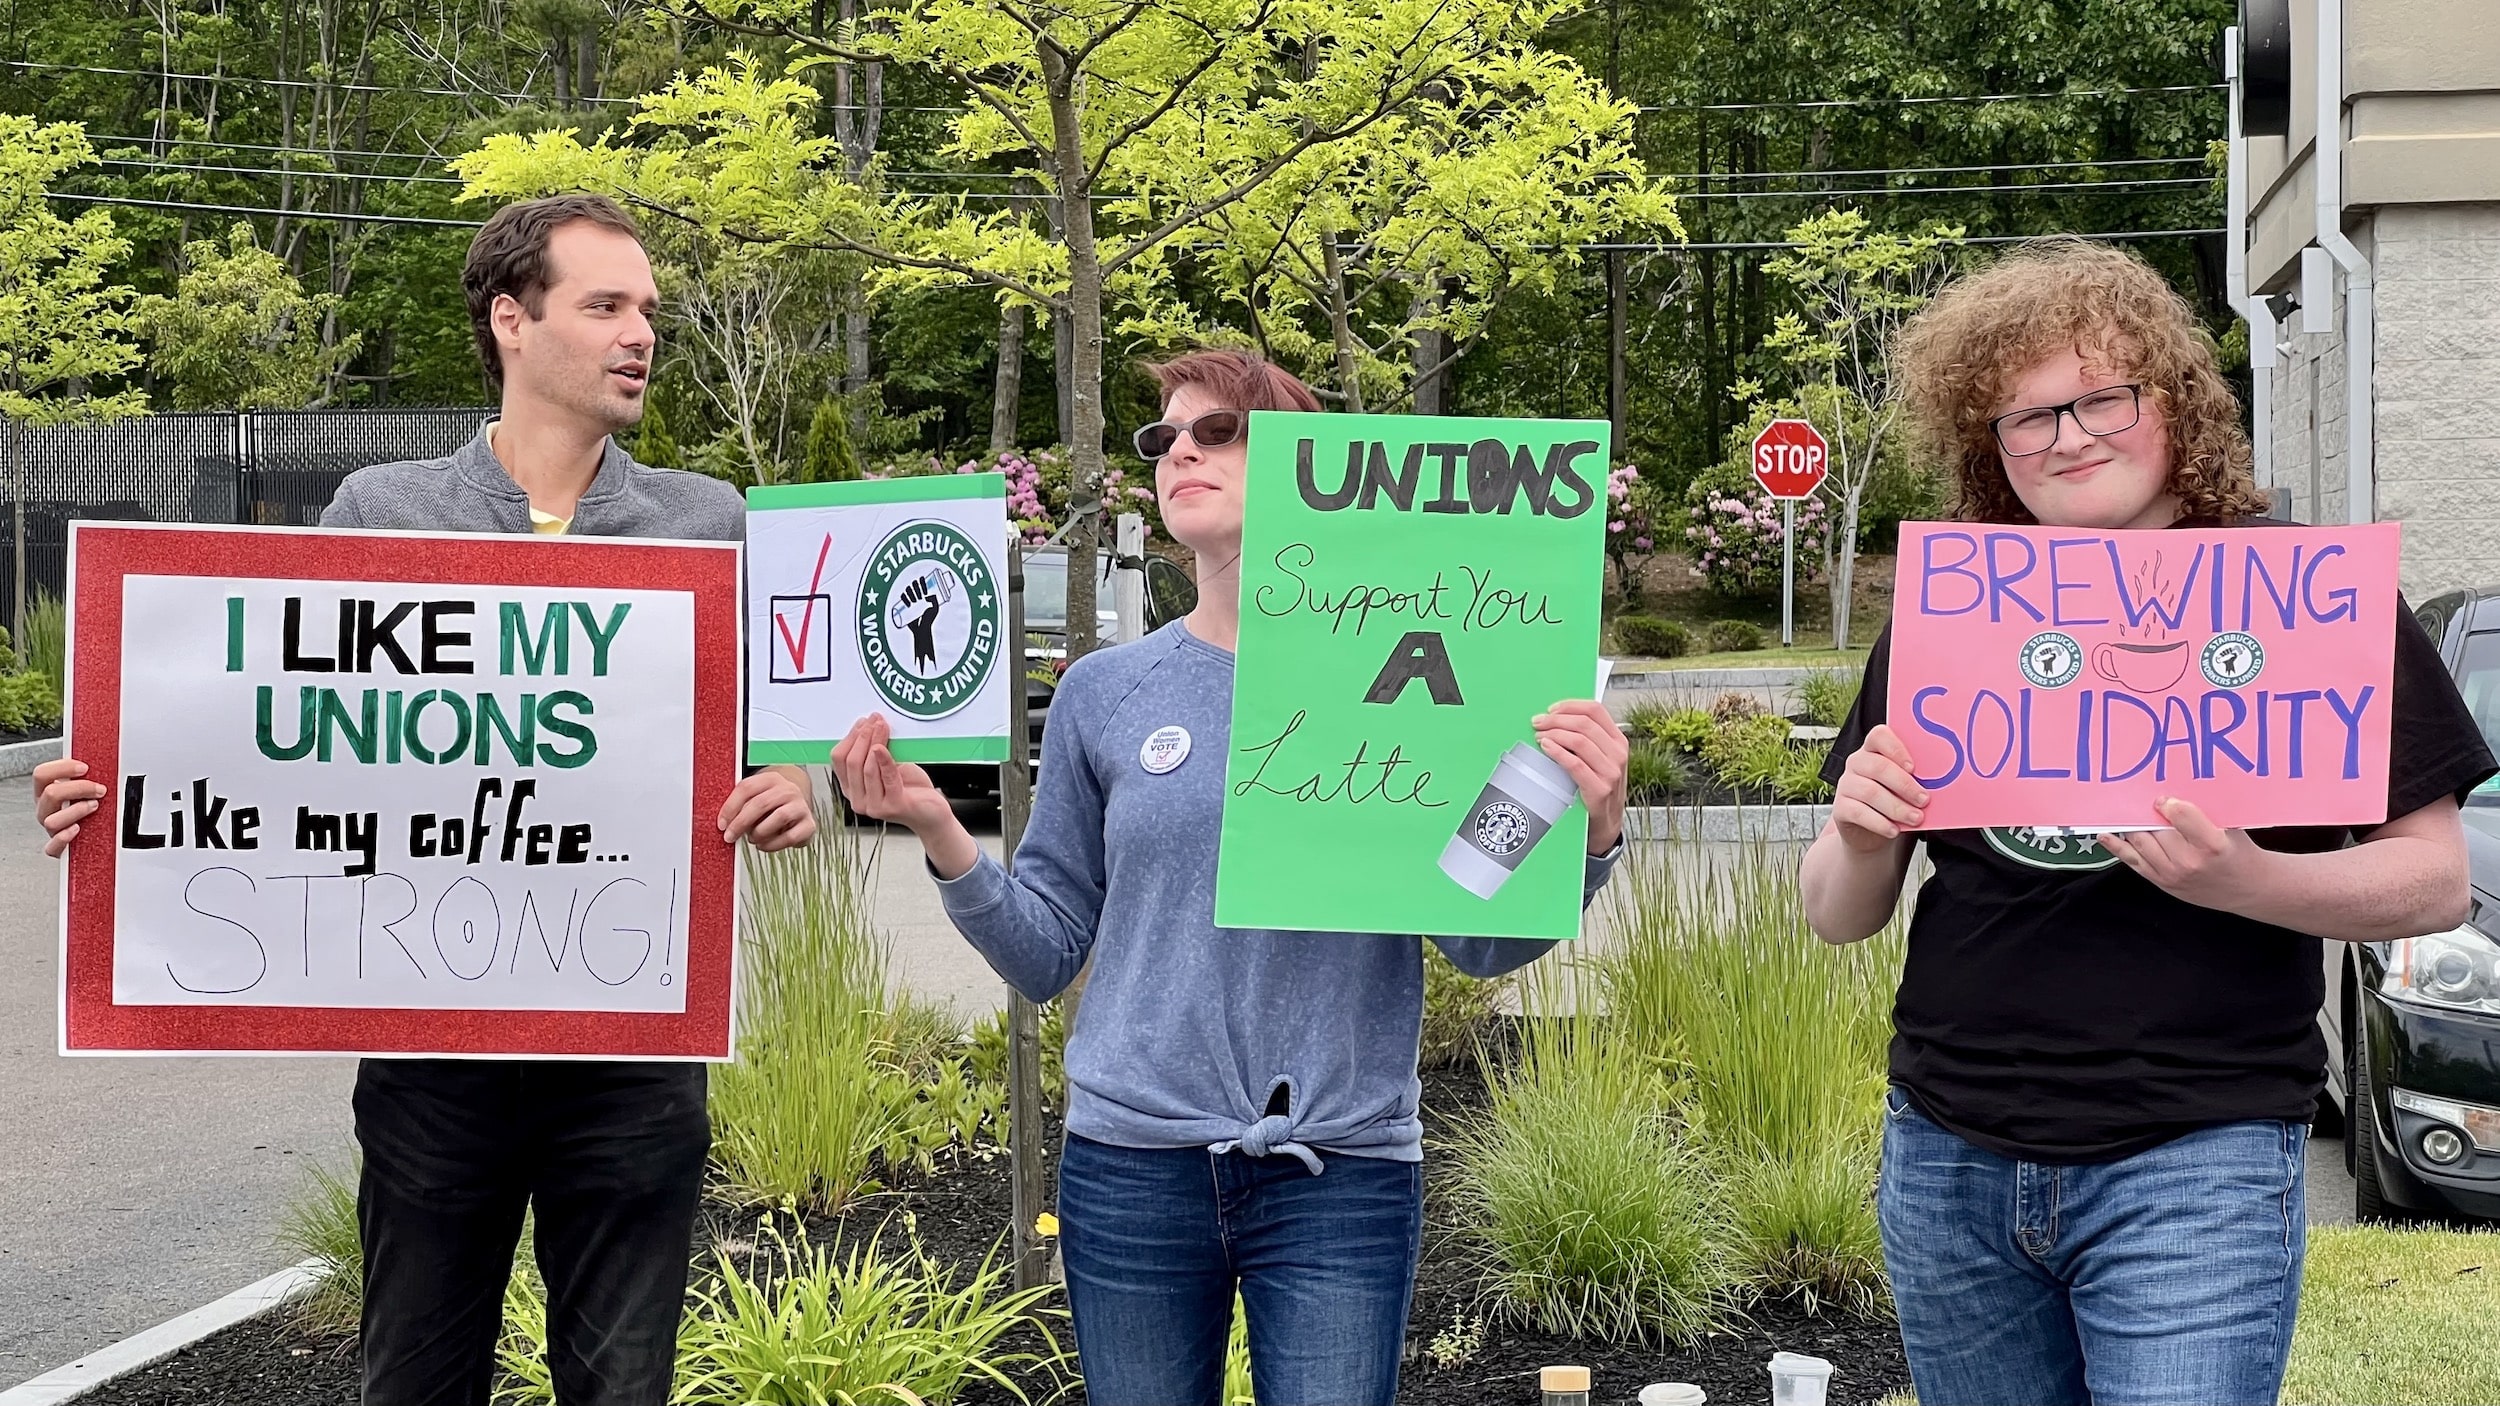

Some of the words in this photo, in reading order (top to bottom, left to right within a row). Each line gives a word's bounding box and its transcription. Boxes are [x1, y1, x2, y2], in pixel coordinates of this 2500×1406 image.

[1296, 438, 1600, 519] UNIONS
[1758, 444, 1822, 475] STOP
[876, 531, 984, 587] STARBUCKS
[1256, 543, 1452, 636] Support
[1459, 566, 1563, 632] You
[1920, 532, 2358, 632] BREWING
[226, 598, 244, 672] I
[283, 597, 475, 675] LIKE
[499, 602, 632, 676] MY
[862, 613, 925, 705] WORKERS
[943, 618, 993, 698] UNITED
[1362, 631, 1464, 705] A
[2021, 655, 2048, 685] WORKERS
[2056, 661, 2080, 684] UNITED
[2029, 634, 2077, 653] STARBUCKS
[2202, 658, 2231, 685] WORKERS
[2238, 658, 2262, 683] UNITED
[2209, 634, 2258, 651] STARBUCKS
[255, 685, 598, 768] UNIONS
[1150, 743, 1179, 752] VOTE
[1234, 709, 1449, 807] Latte
[1911, 685, 2375, 789] SOLIDARITY
[122, 775, 260, 850] Like
[296, 803, 379, 877] my
[1478, 828, 1508, 853] COFFEE
[1485, 804, 1527, 839] STARBUCKS
[166, 866, 676, 994] STRONG!
